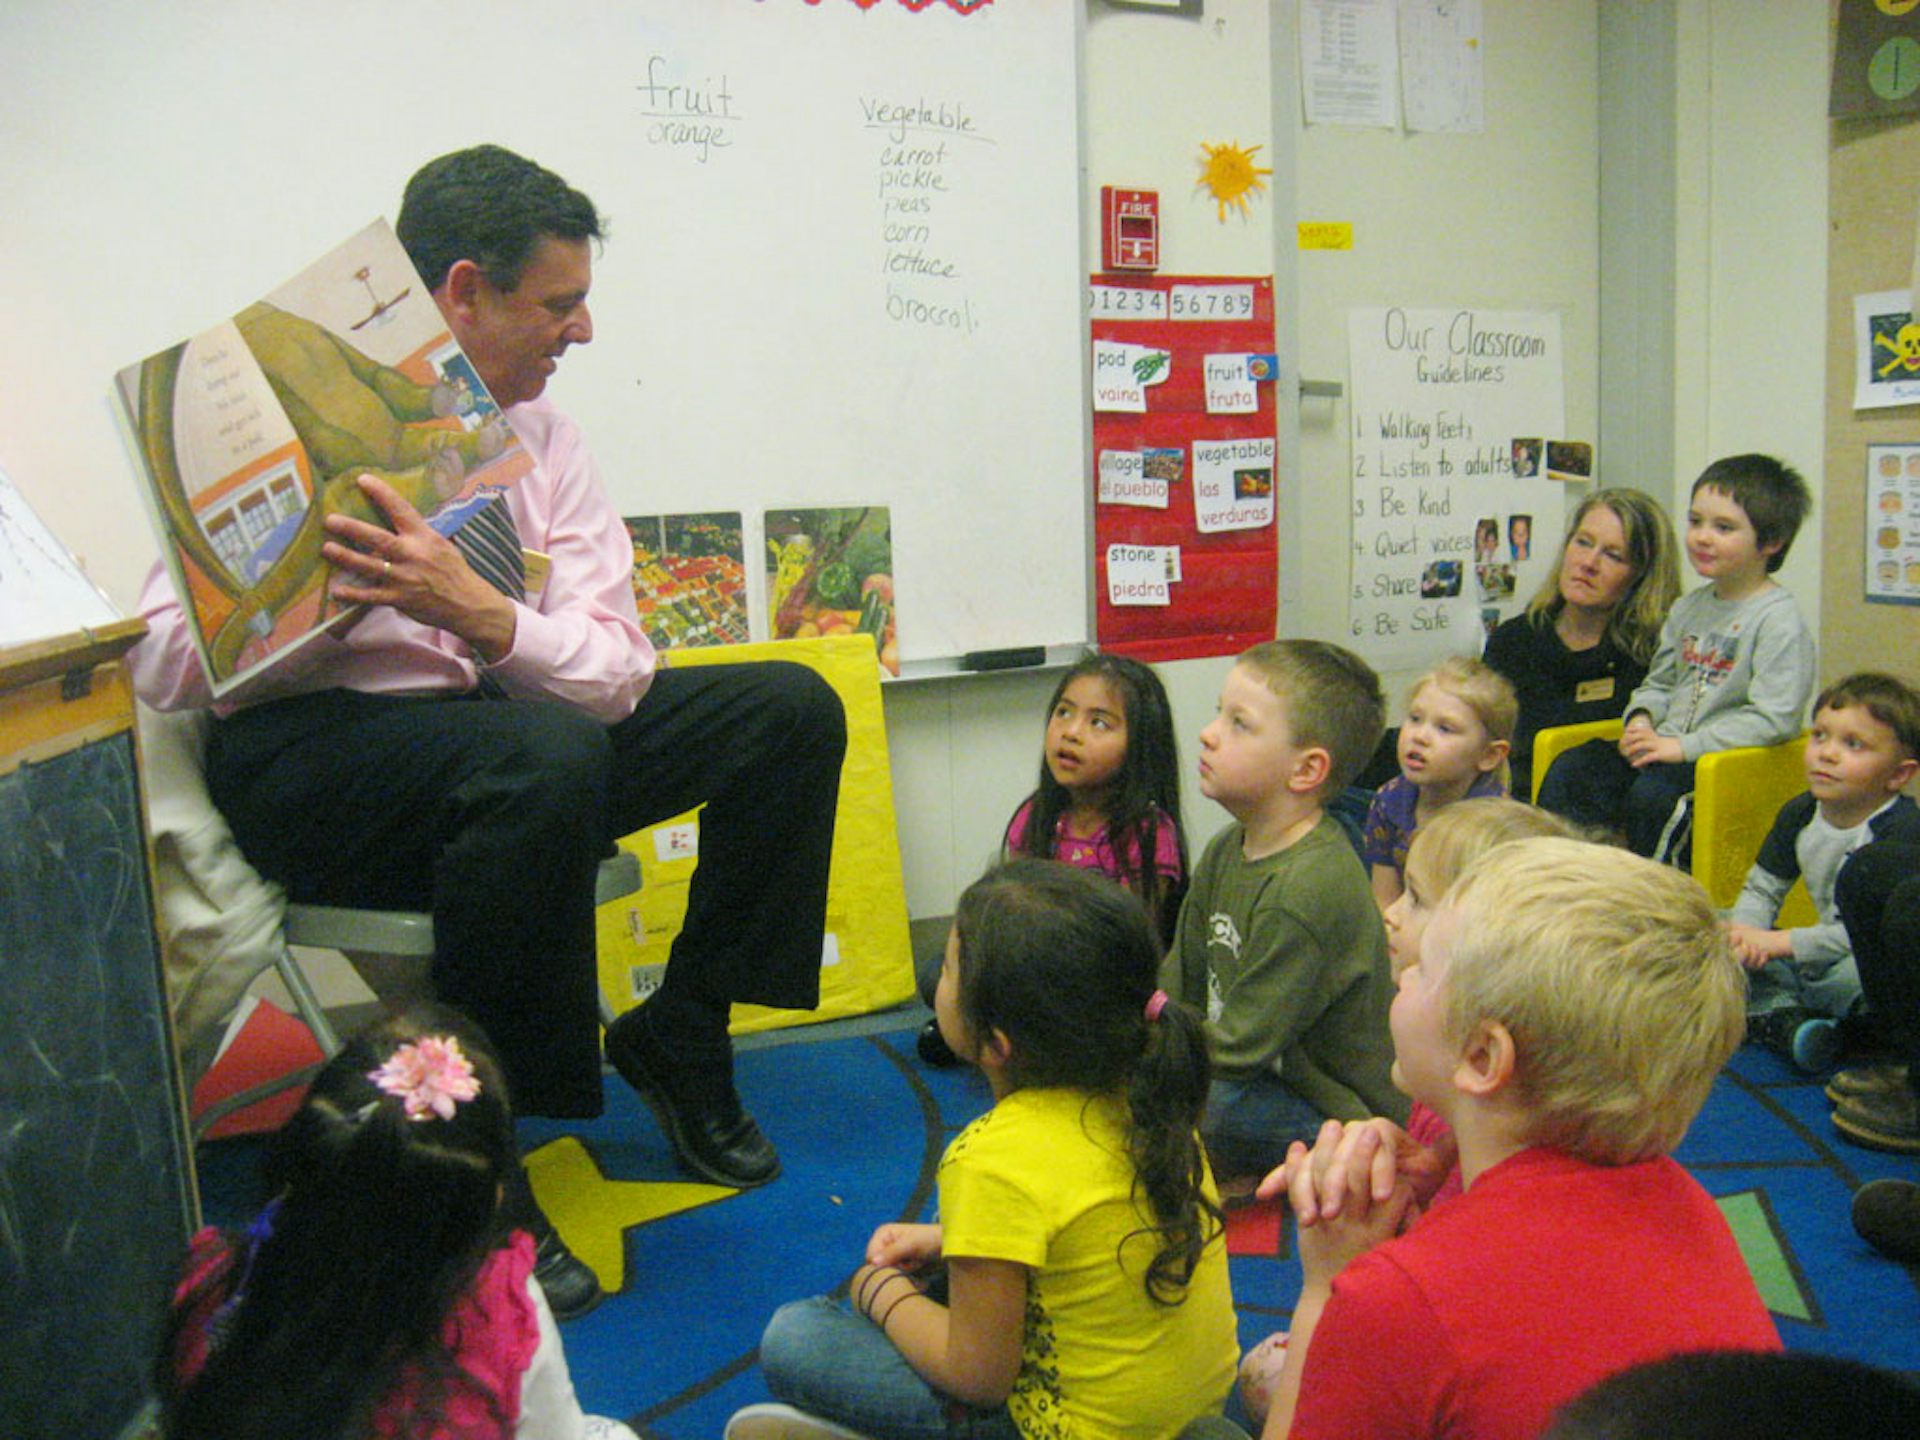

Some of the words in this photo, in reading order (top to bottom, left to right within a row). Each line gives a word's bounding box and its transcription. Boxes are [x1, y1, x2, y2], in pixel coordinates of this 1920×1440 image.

[636, 56, 733, 115] fruit
[647, 122, 733, 162] orange
[880, 141, 951, 167] carrot
[878, 167, 950, 198] pickle
[884, 196, 931, 219] peas
[1121, 202, 1152, 216] FIRE
[884, 223, 931, 244] corn
[882, 249, 961, 278] lettuce
[1384, 308, 1434, 351] Our
[1448, 310, 1546, 358] Classroom
[1097, 350, 1127, 368] pod
[1416, 355, 1505, 384] Guidelines
[1207, 363, 1244, 381] fruit
[1098, 386, 1140, 402] vaina
[1208, 391, 1253, 407] fruta
[1379, 410, 1431, 450] Walking
[1101, 455, 1143, 475] vage
[1196, 442, 1274, 466] vegetable
[1356, 455, 1366, 478] 2
[1379, 449, 1431, 478] Listen
[1439, 450, 1454, 476] to
[1465, 446, 1511, 475] adults
[1113, 480, 1168, 499] pueblo
[1199, 480, 1220, 497] las
[1354, 500, 1365, 518] 3
[1380, 487, 1407, 518] Be
[1419, 486, 1451, 516] Kind
[1201, 505, 1268, 526] verduras
[1110, 547, 1156, 562] stone
[1430, 533, 1473, 554] voices
[1112, 579, 1166, 600] piedra
[1352, 618, 1363, 636] 6
[1375, 613, 1398, 636] Be
[1410, 605, 1450, 632] Safe
